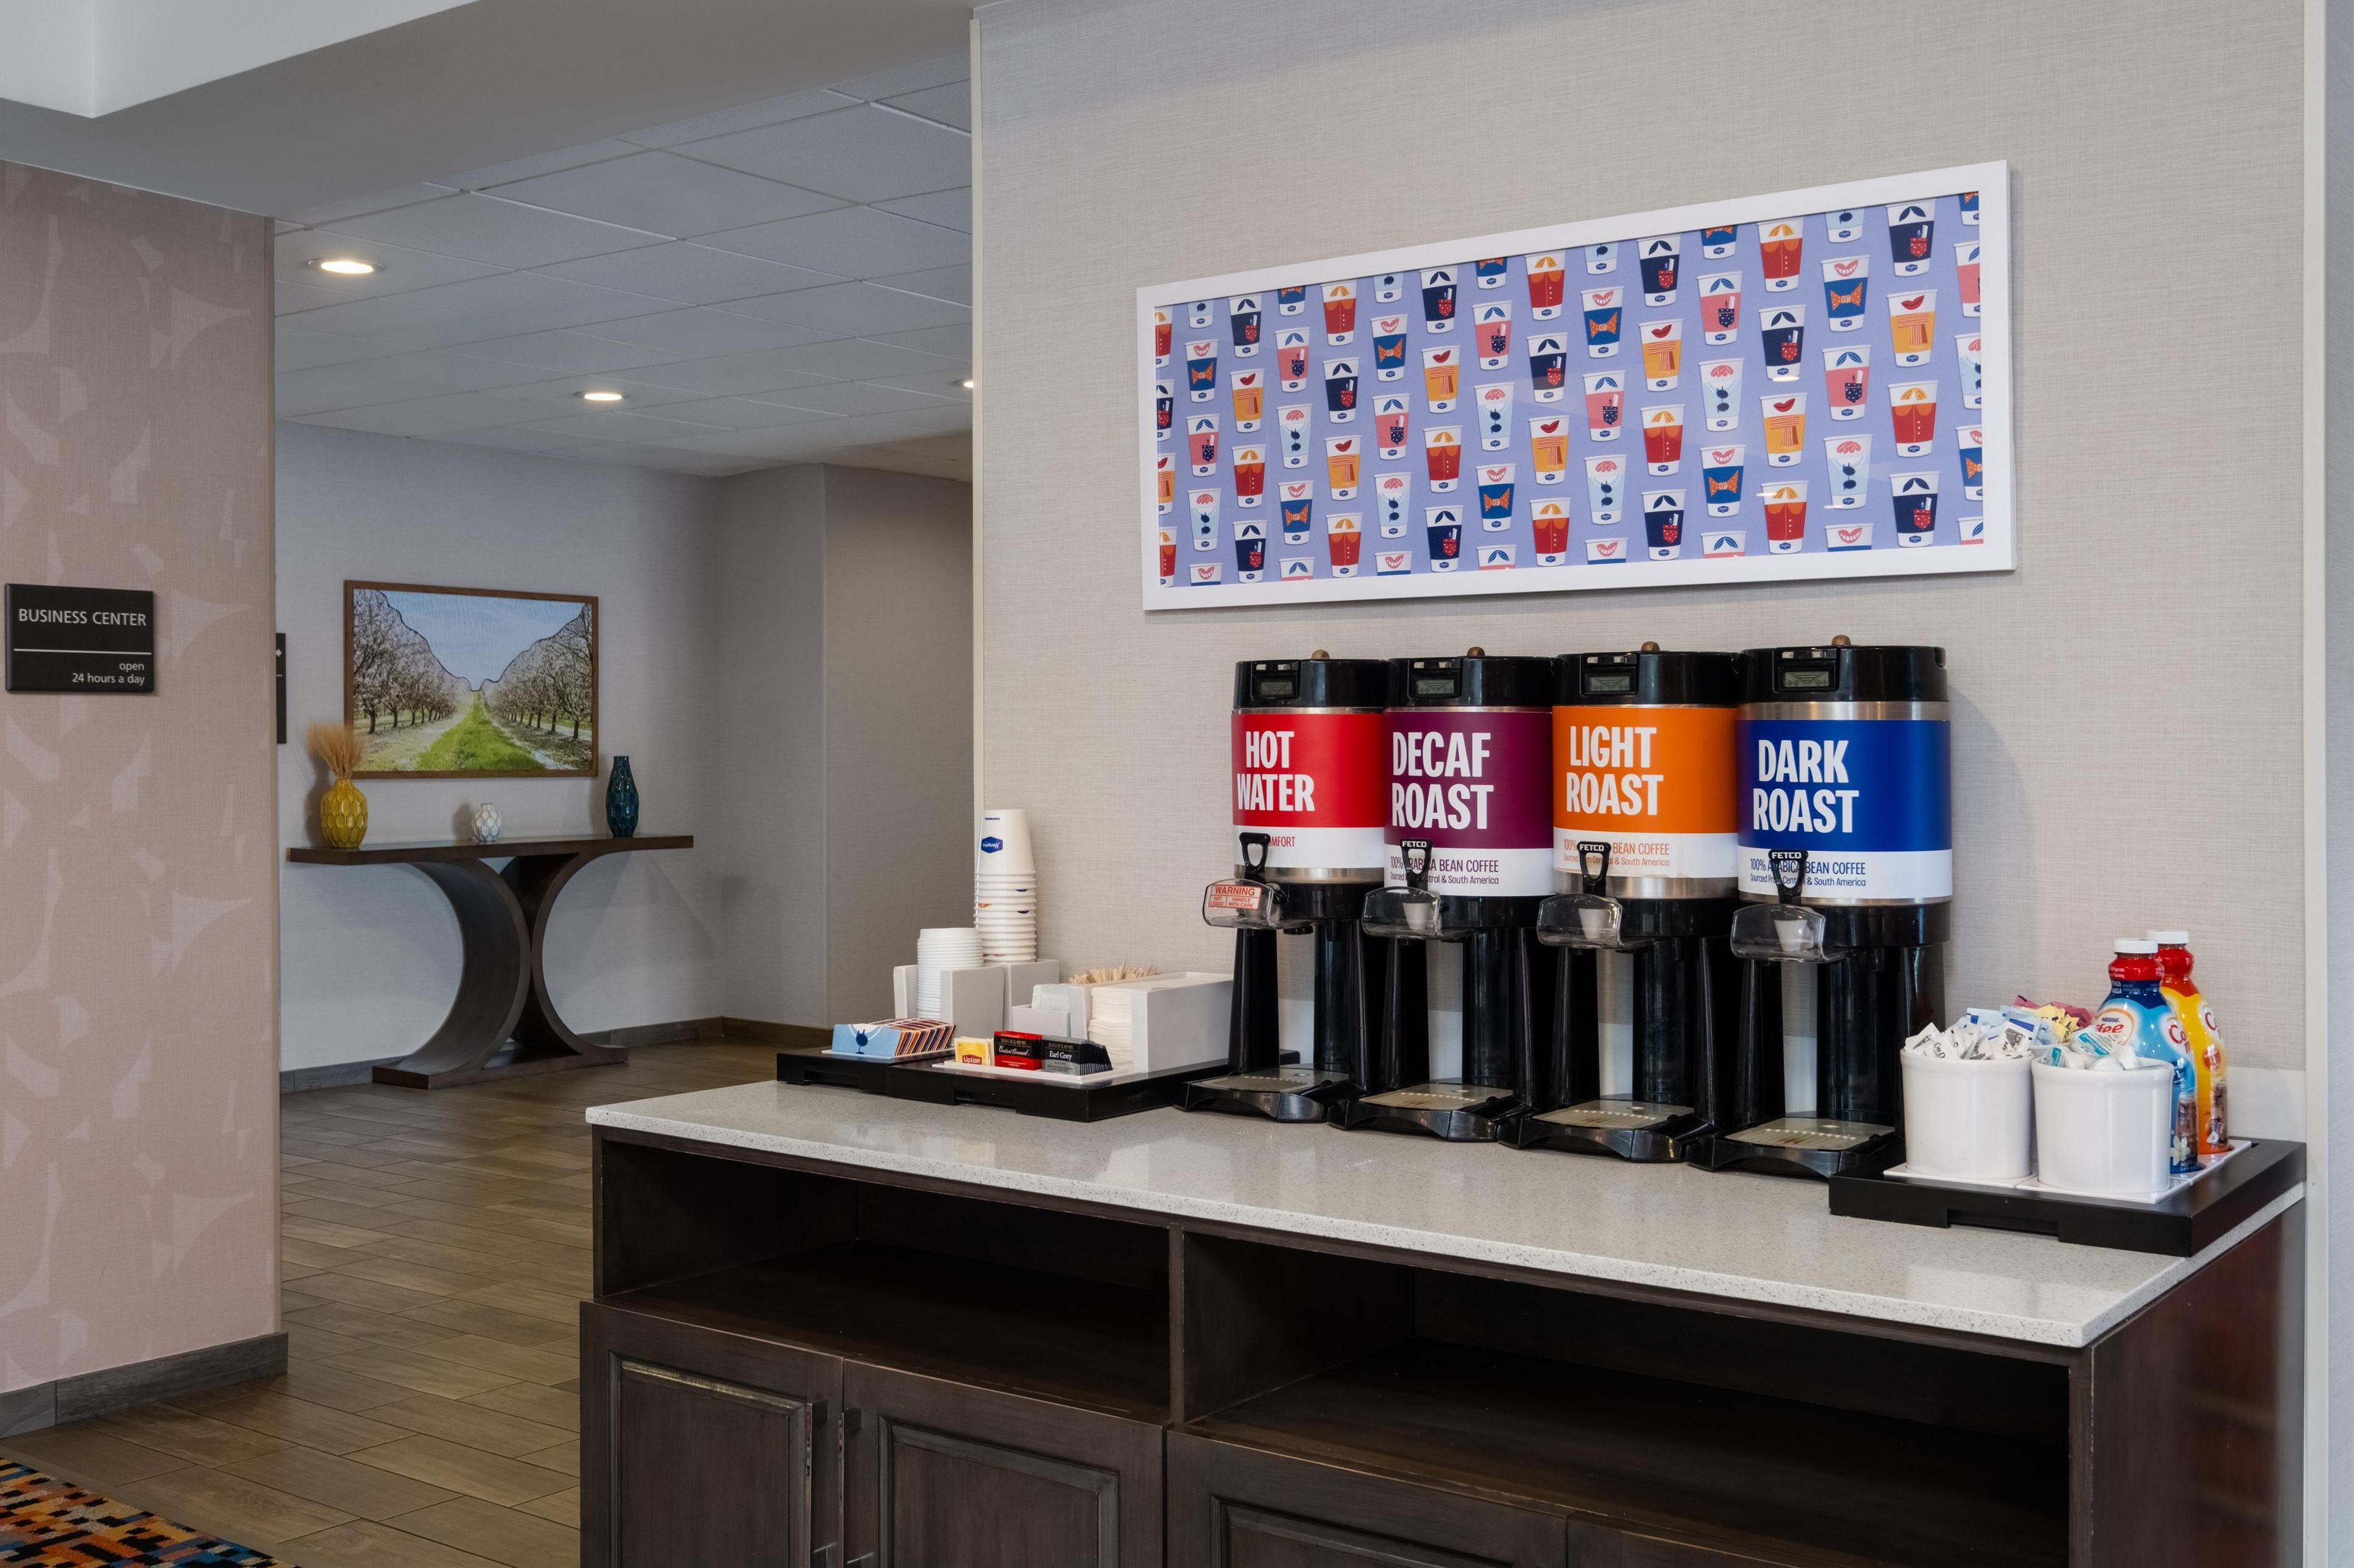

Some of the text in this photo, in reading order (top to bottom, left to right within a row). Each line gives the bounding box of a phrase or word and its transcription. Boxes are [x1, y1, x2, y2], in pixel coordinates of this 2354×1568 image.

[19, 609, 147, 626] BUSINESS CENTER
[119, 663, 144, 672] open
[72, 672, 85, 683] 24
[87, 672, 115, 683] hours
[127, 674, 145, 686] day
[1245, 730, 1294, 769] HOT
[1393, 731, 1491, 777] DECAF
[1570, 726, 1657, 768] LIGHT
[1758, 739, 1849, 783] DARK
[1237, 773, 1315, 812] WATER
[1566, 772, 1664, 816] ROAST
[1392, 783, 1494, 830] ROAST
[1753, 788, 1860, 833] ROAST
[1564, 839, 1669, 855] 100% BEAN COFFEE
[1390, 856, 1403, 869] 100%
[1439, 859, 1463, 872] BEAN
[1466, 859, 1499, 872] COFFEE
[1621, 857, 1640, 866] South
[1750, 858, 1766, 871] 100%
[1806, 861, 1829, 874] BEAN
[1833, 862, 1866, 875] COFFEE
[1390, 871, 1404, 881] Sourced
[1448, 875, 1469, 884] South
[1470, 876, 1499, 885] America
[1750, 874, 1767, 883] Sourced
[1814, 877, 1834, 886] South
[1836, 877, 1866, 886] America
[1215, 886, 1255, 896] WARNING
[963, 1056, 980, 1064] Lipton
[1060, 1051, 1072, 1061] Grey
